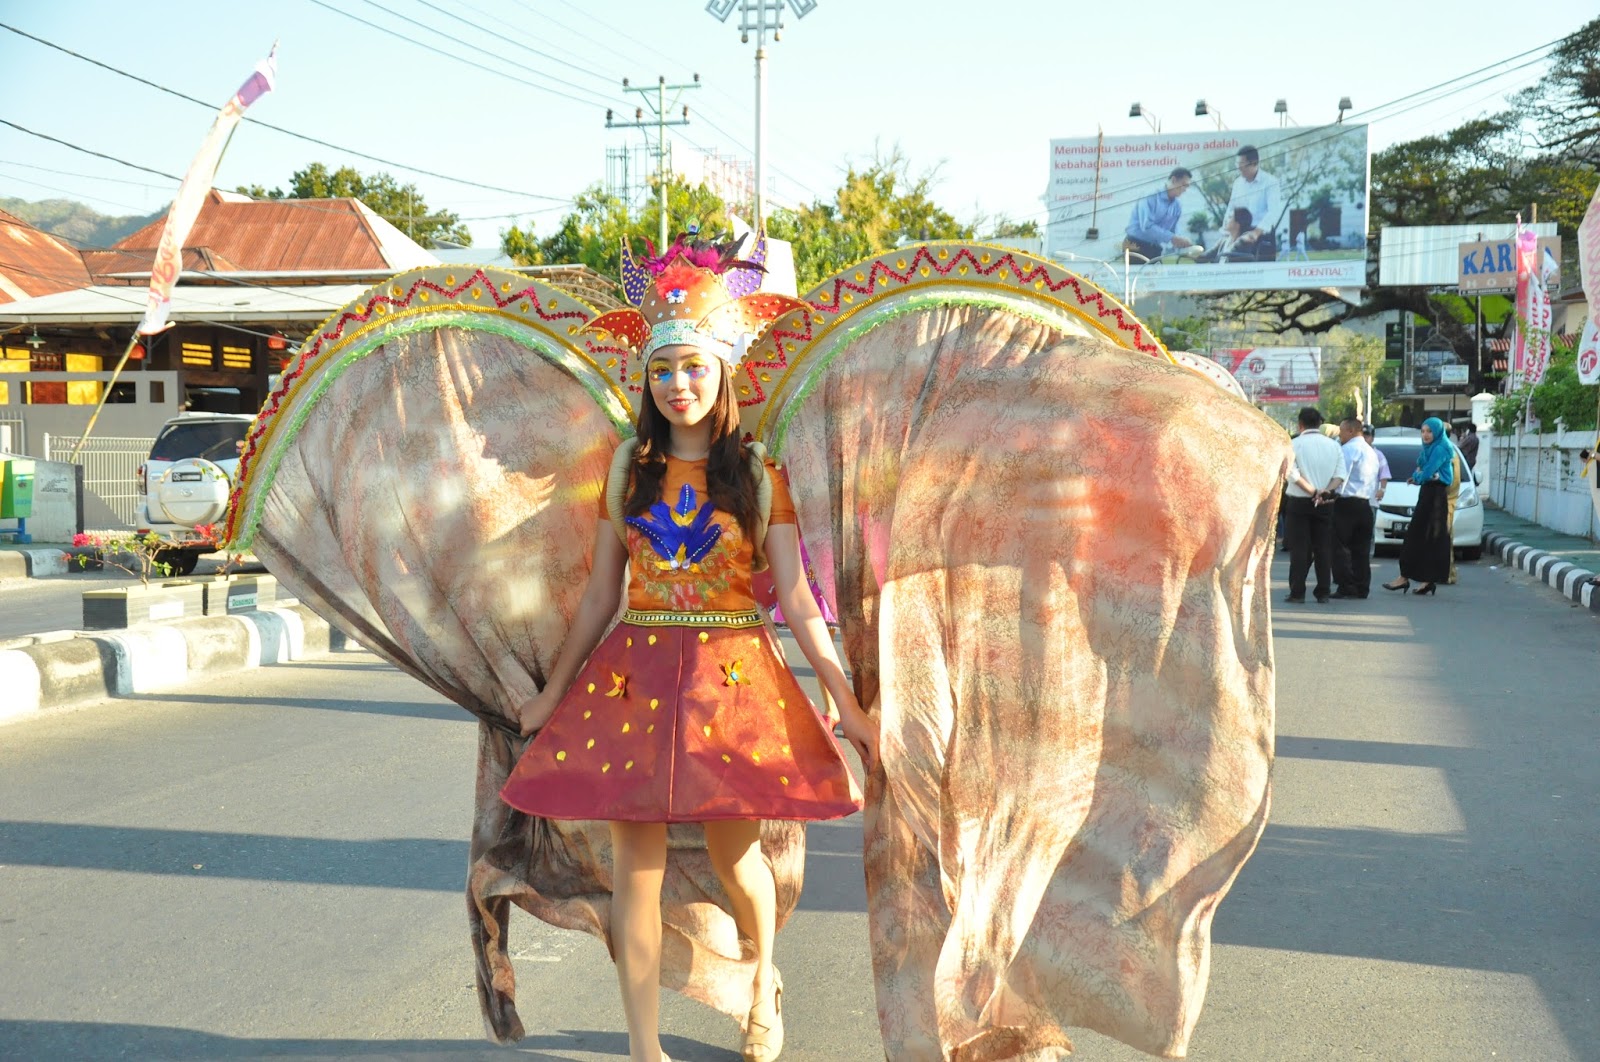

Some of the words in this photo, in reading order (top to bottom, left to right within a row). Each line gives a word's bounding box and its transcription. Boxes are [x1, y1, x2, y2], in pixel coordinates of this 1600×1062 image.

[1114, 142, 1152, 153] sebuah
[1154, 140, 1200, 154] keluarga
[1203, 138, 1239, 150] adalah
[1126, 156, 1180, 168] tersendiri.
[1055, 176, 1108, 186] #SiapkahAda
[1288, 267, 1343, 277] PRUDENTIAL
